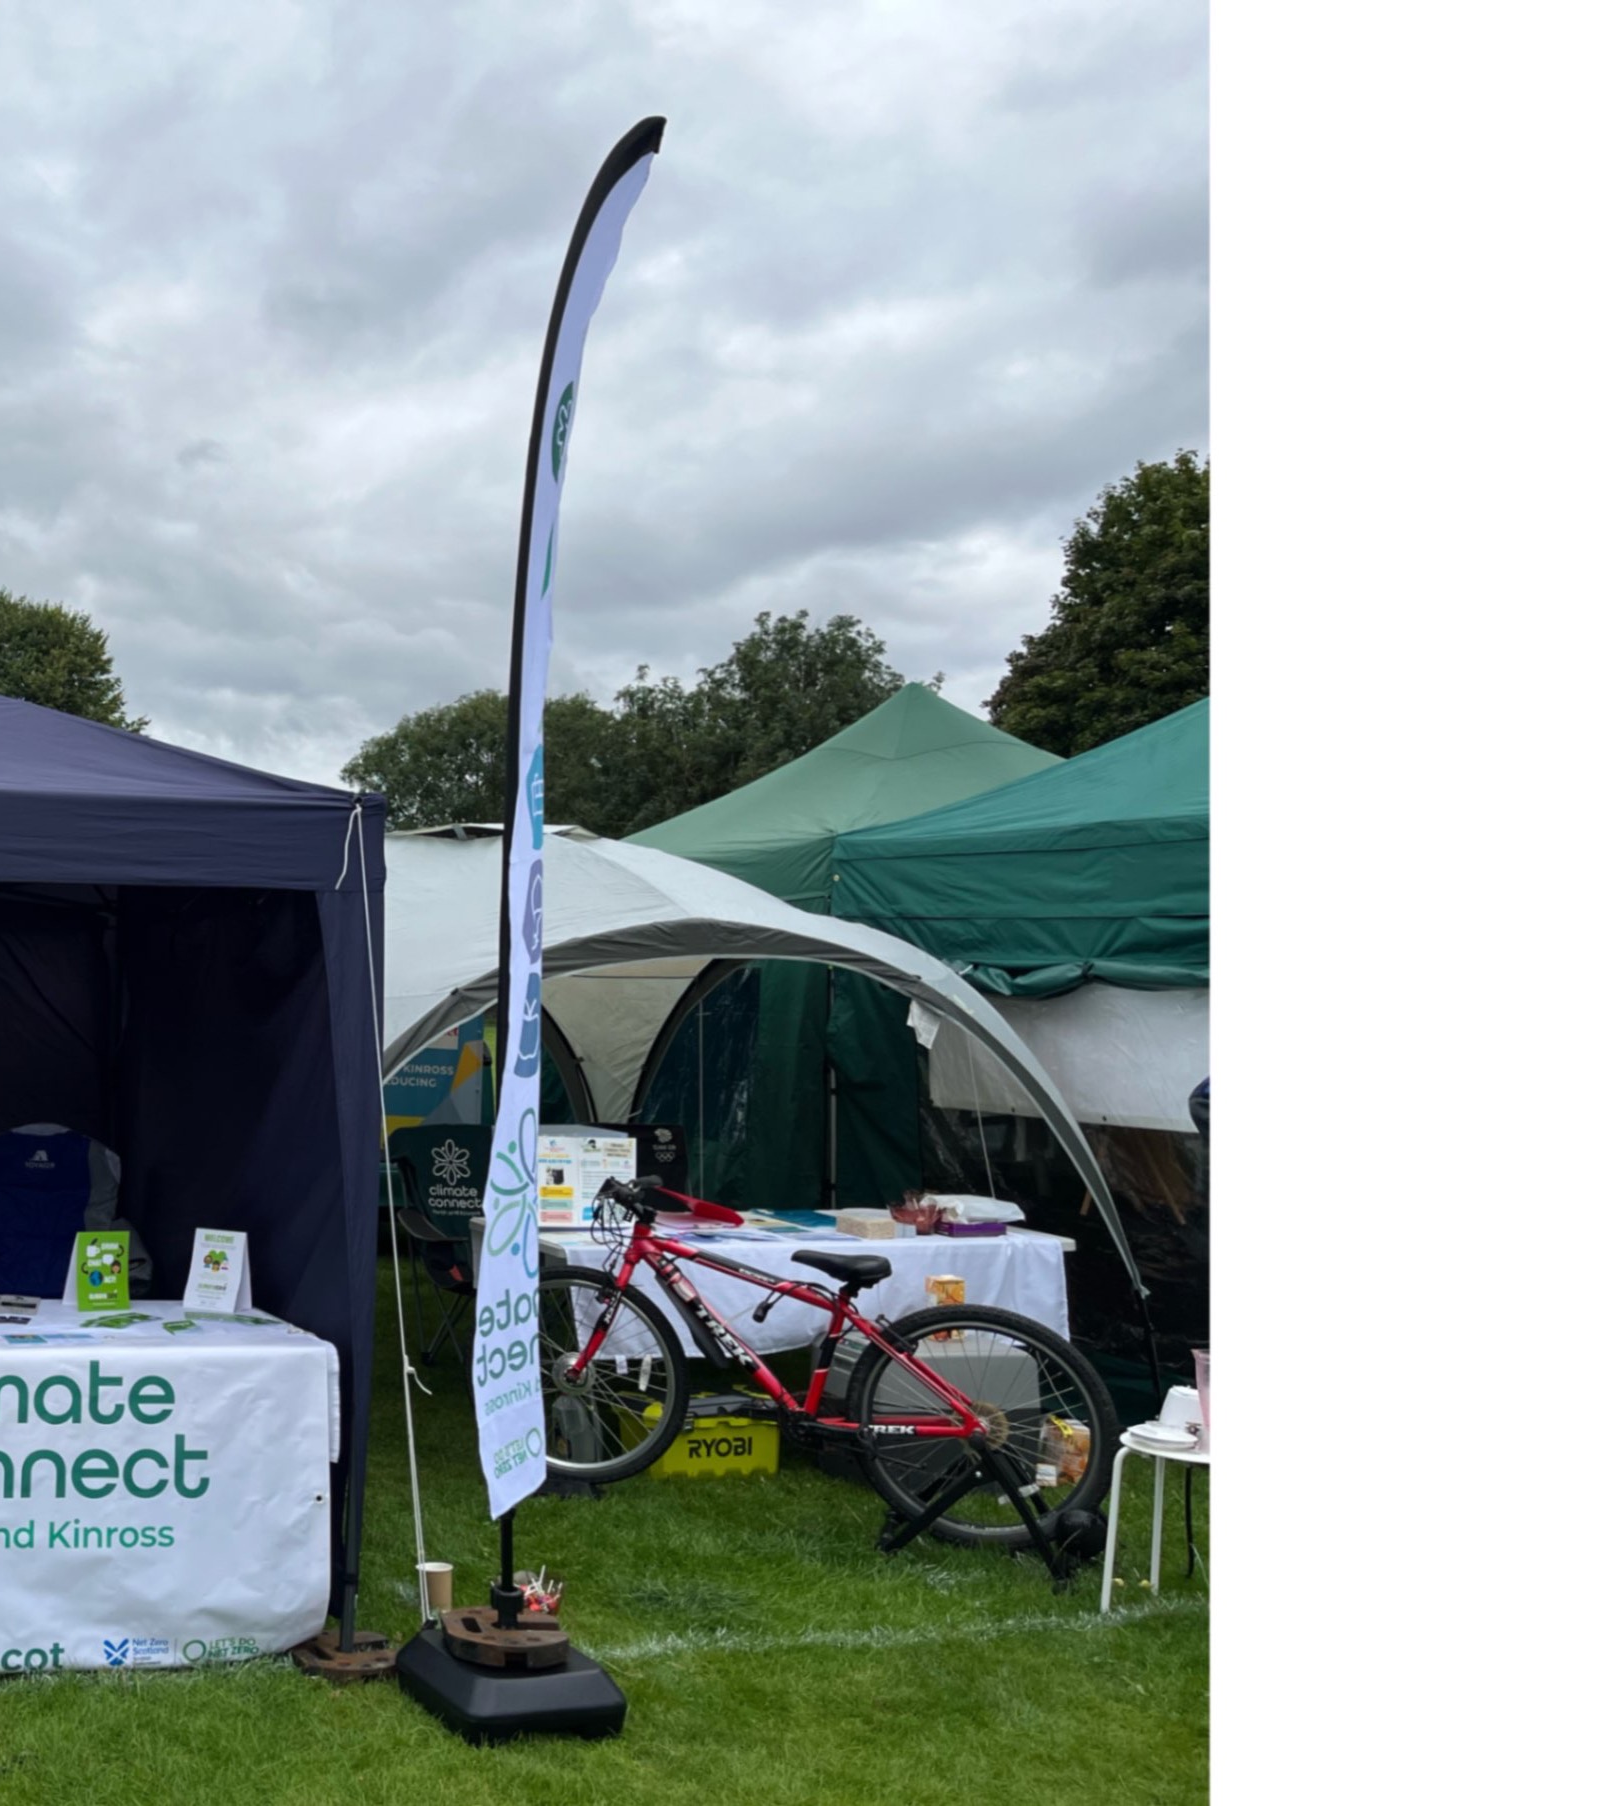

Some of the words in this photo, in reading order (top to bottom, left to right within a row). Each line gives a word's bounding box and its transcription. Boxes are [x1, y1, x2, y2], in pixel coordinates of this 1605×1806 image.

[403, 1064, 454, 1076] KINROSS
[386, 1077, 438, 1088] DUCING
[428, 1184, 478, 1197] climate
[428, 1197, 482, 1209] connect
[695, 1304, 753, 1366] TREK
[687, 1436, 753, 1459] RYOBI
[48, 1518, 175, 1549] Kinross
[132, 1638, 145, 1647] Net
[149, 1638, 169, 1647] Zero
[239, 1638, 256, 1646] DO
[133, 1646, 169, 1656] Scotland
[231, 1646, 259, 1655] ZERO
